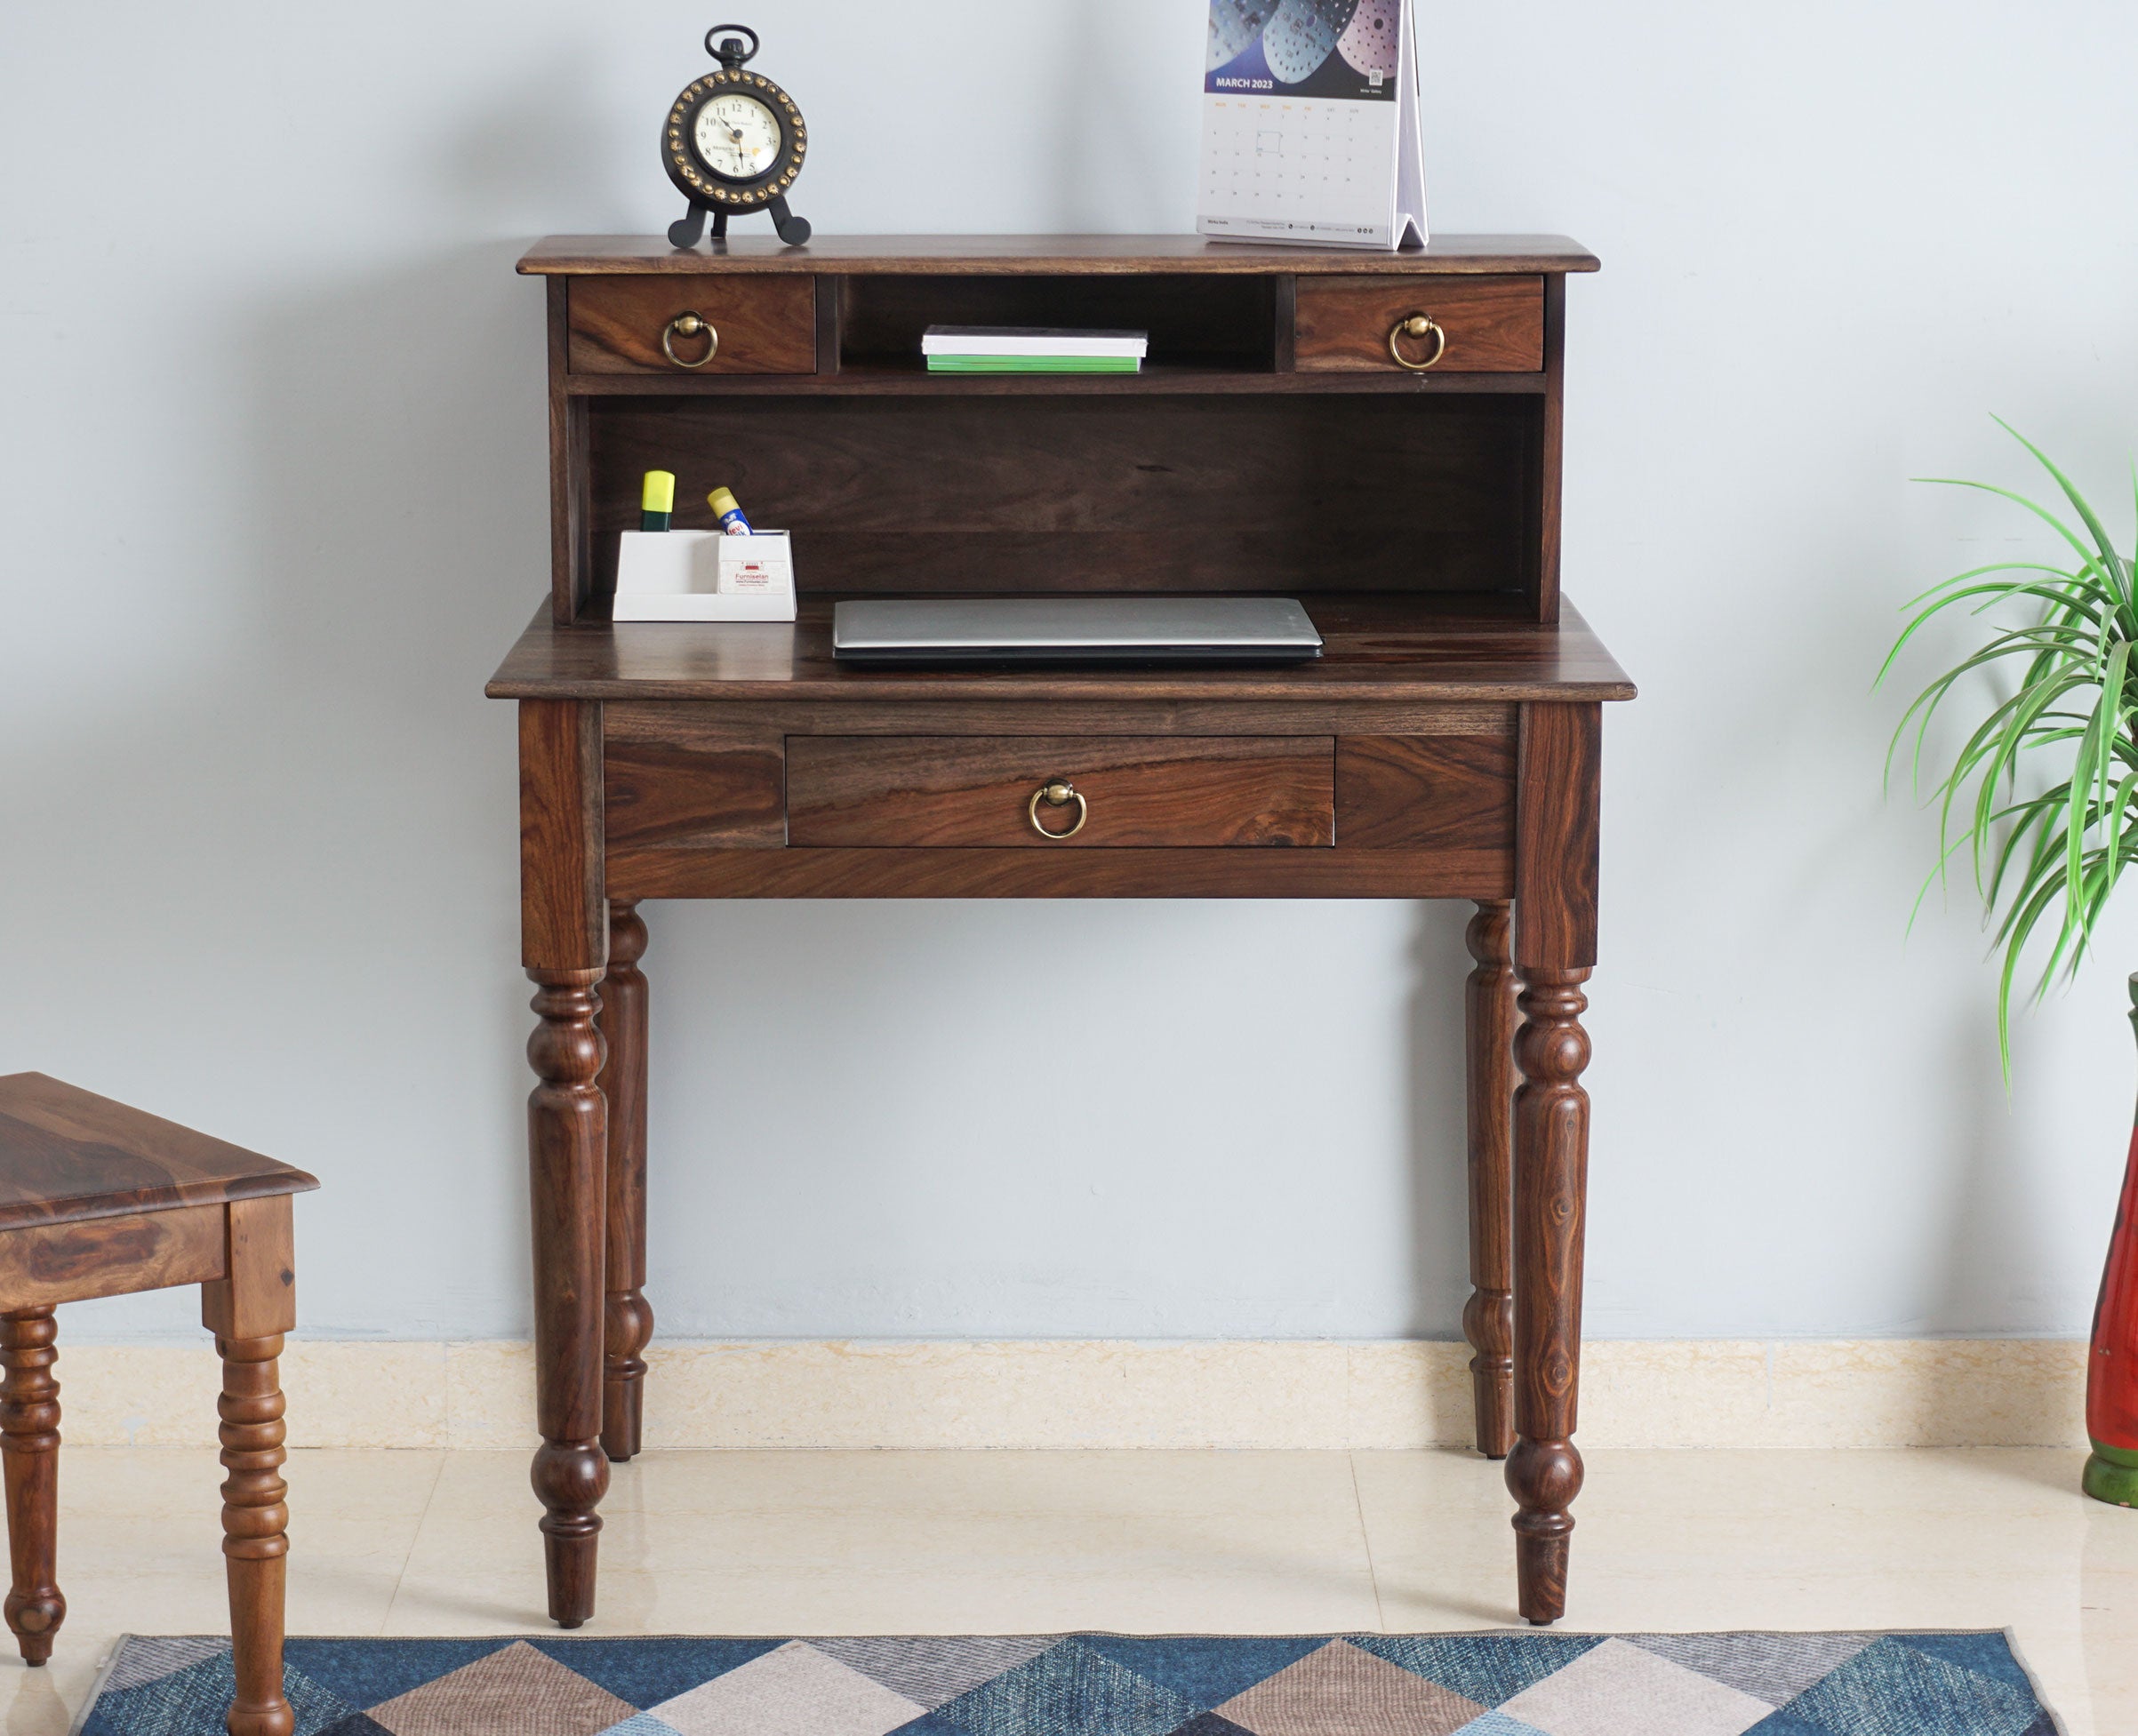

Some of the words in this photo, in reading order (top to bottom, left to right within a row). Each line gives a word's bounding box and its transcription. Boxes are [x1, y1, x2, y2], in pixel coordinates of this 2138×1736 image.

[1216, 77, 1251, 88] MARCH
[1251, 79, 1274, 89] 2023
[717, 108, 725, 116] 11
[732, 103, 741, 113] 12
[750, 108, 755, 117] 1
[705, 117, 717, 126] 10
[763, 120, 768, 130] 2
[701, 131, 707, 140] 9
[766, 136, 772, 146] 3
[705, 147, 711, 156] 8
[717, 159, 723, 169] 7
[733, 164, 739, 173] 6
[749, 162, 756, 172] 5
